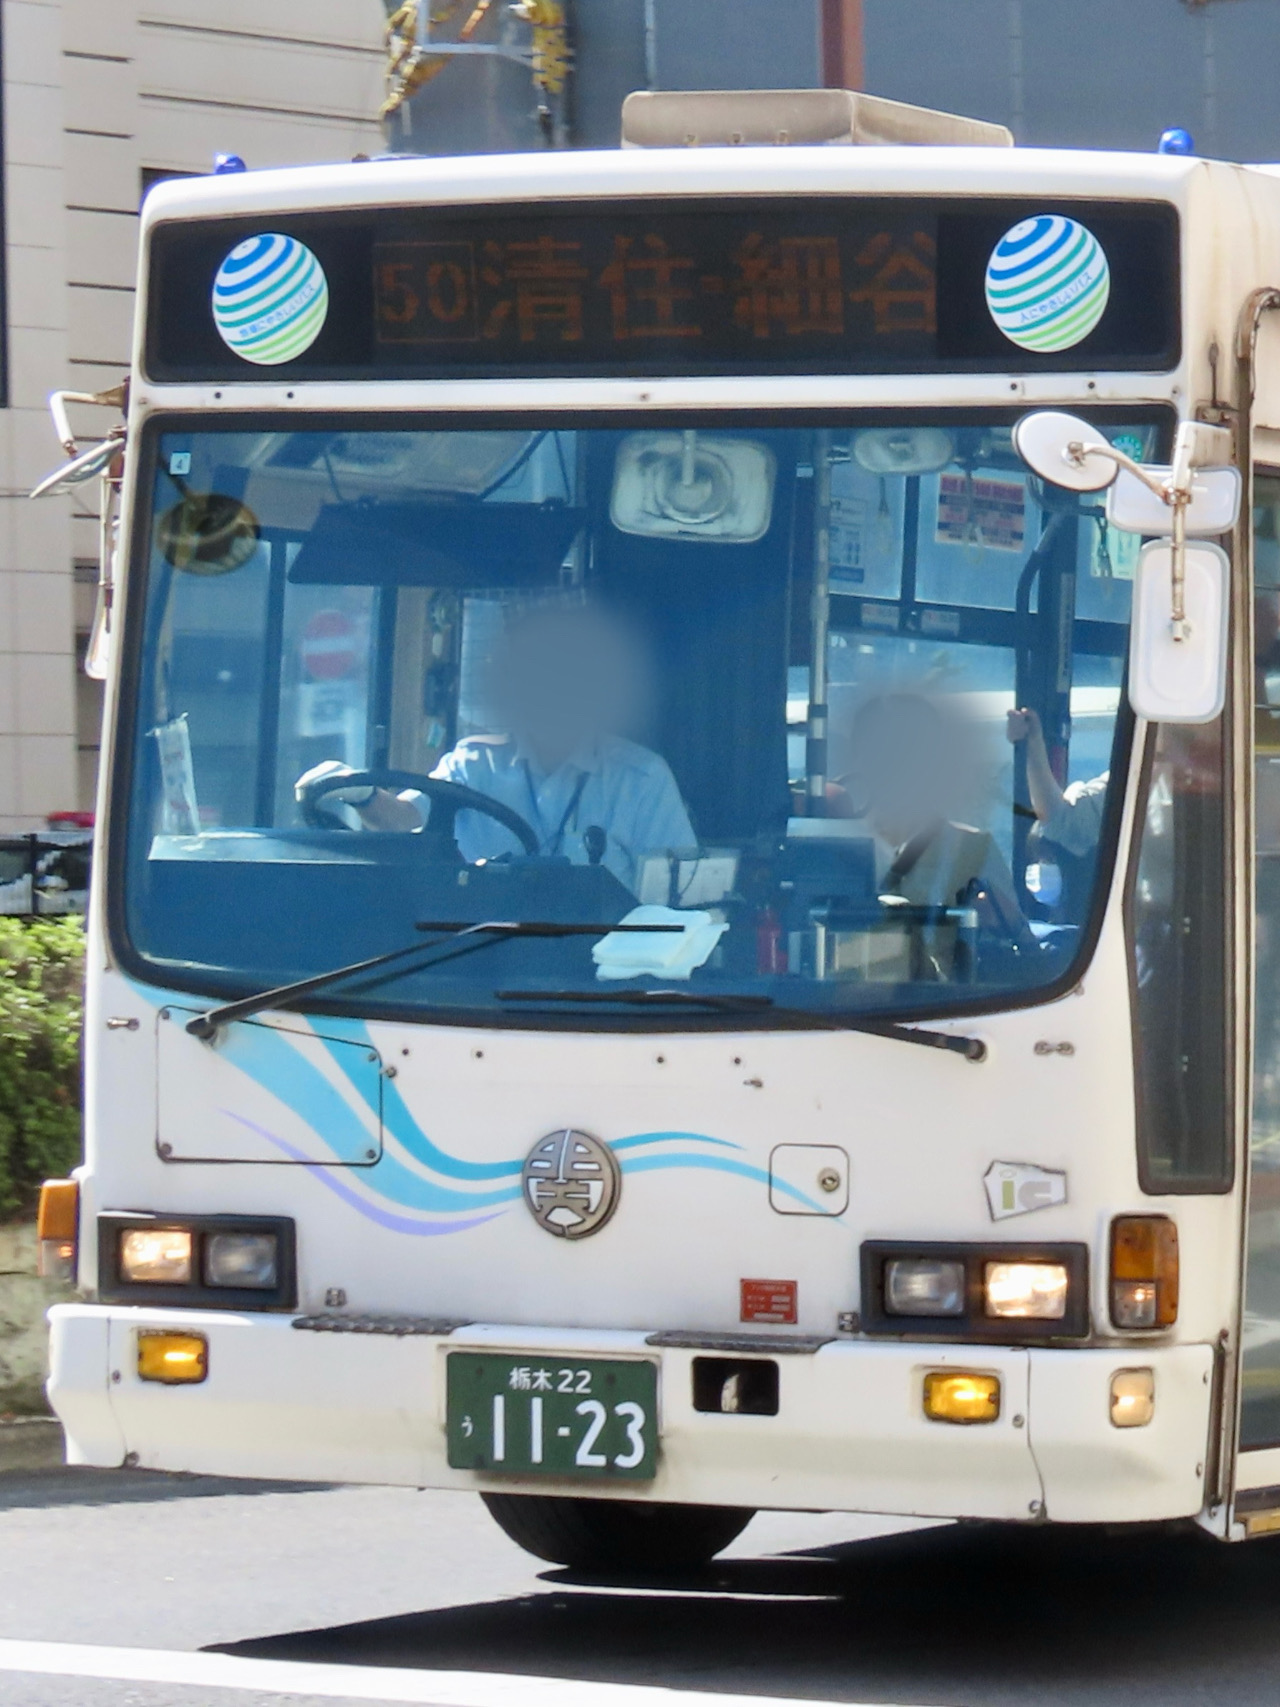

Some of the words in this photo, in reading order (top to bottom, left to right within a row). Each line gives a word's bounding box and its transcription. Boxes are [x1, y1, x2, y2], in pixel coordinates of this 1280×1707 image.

[381, 261, 467, 324] 50
[508, 1367, 553, 1391] 栃木
[557, 1369, 592, 1394] 22
[461, 1415, 474, 1438] う
[493, 1394, 646, 1469] 11-23
